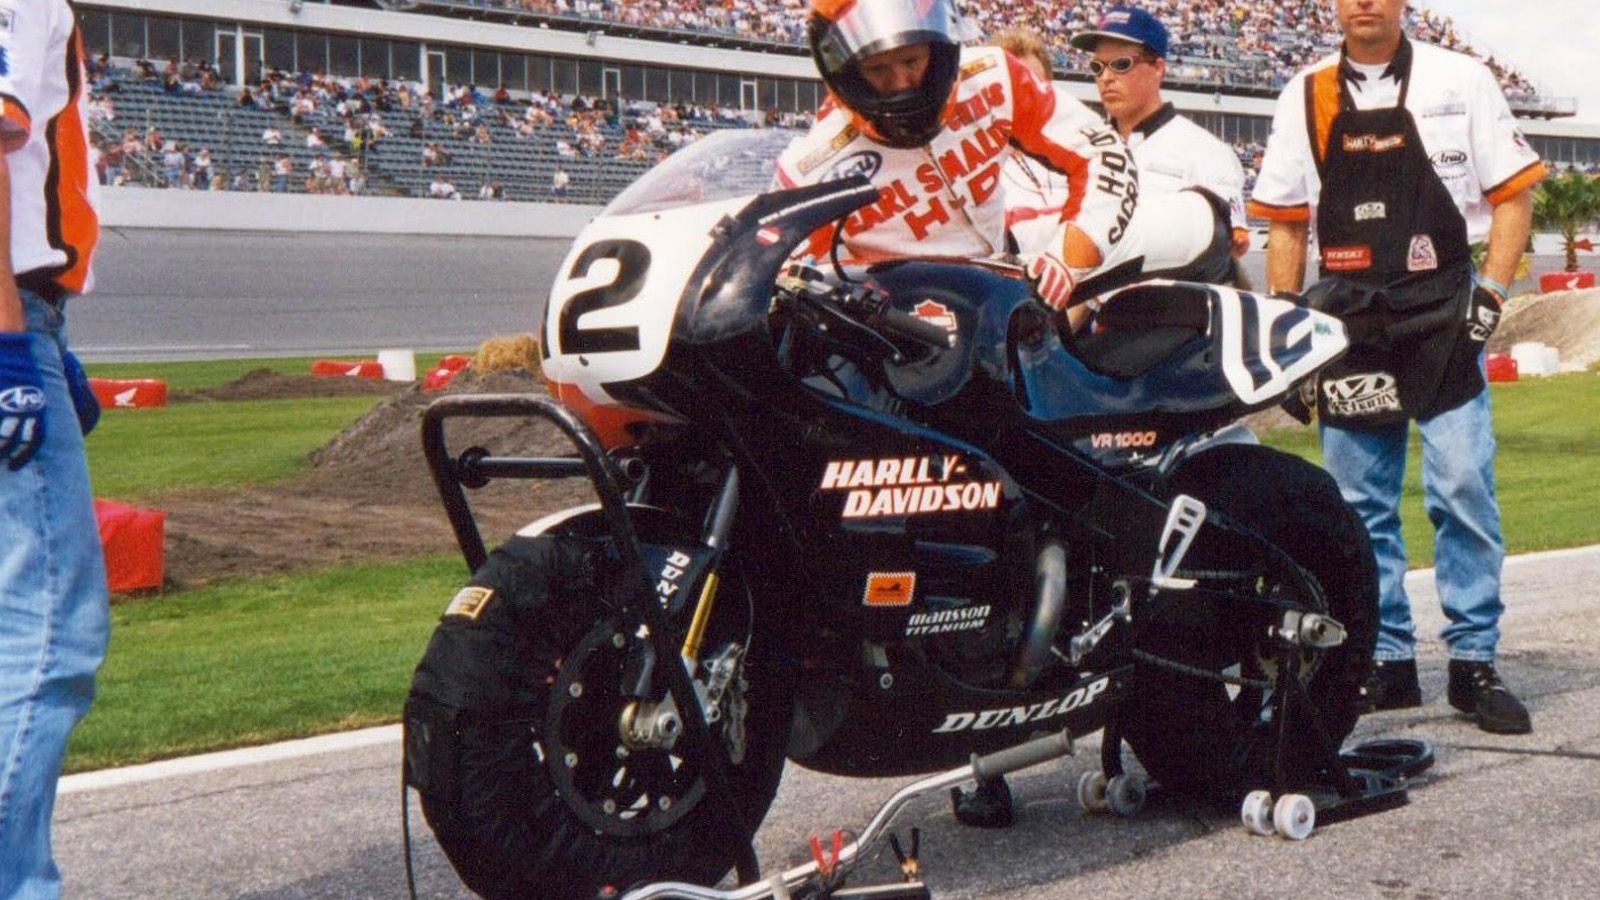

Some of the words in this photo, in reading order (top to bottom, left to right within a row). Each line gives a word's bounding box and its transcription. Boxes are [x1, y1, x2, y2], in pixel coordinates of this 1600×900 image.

[903, 162, 1001, 241] H-D
[1090, 433, 1113, 449] VR
[1114, 431, 1157, 448] 1000
[842, 482, 1001, 518] DAVIDSON
[905, 618, 986, 637] TITANIUM
[931, 676, 1110, 734] DUNLOP
